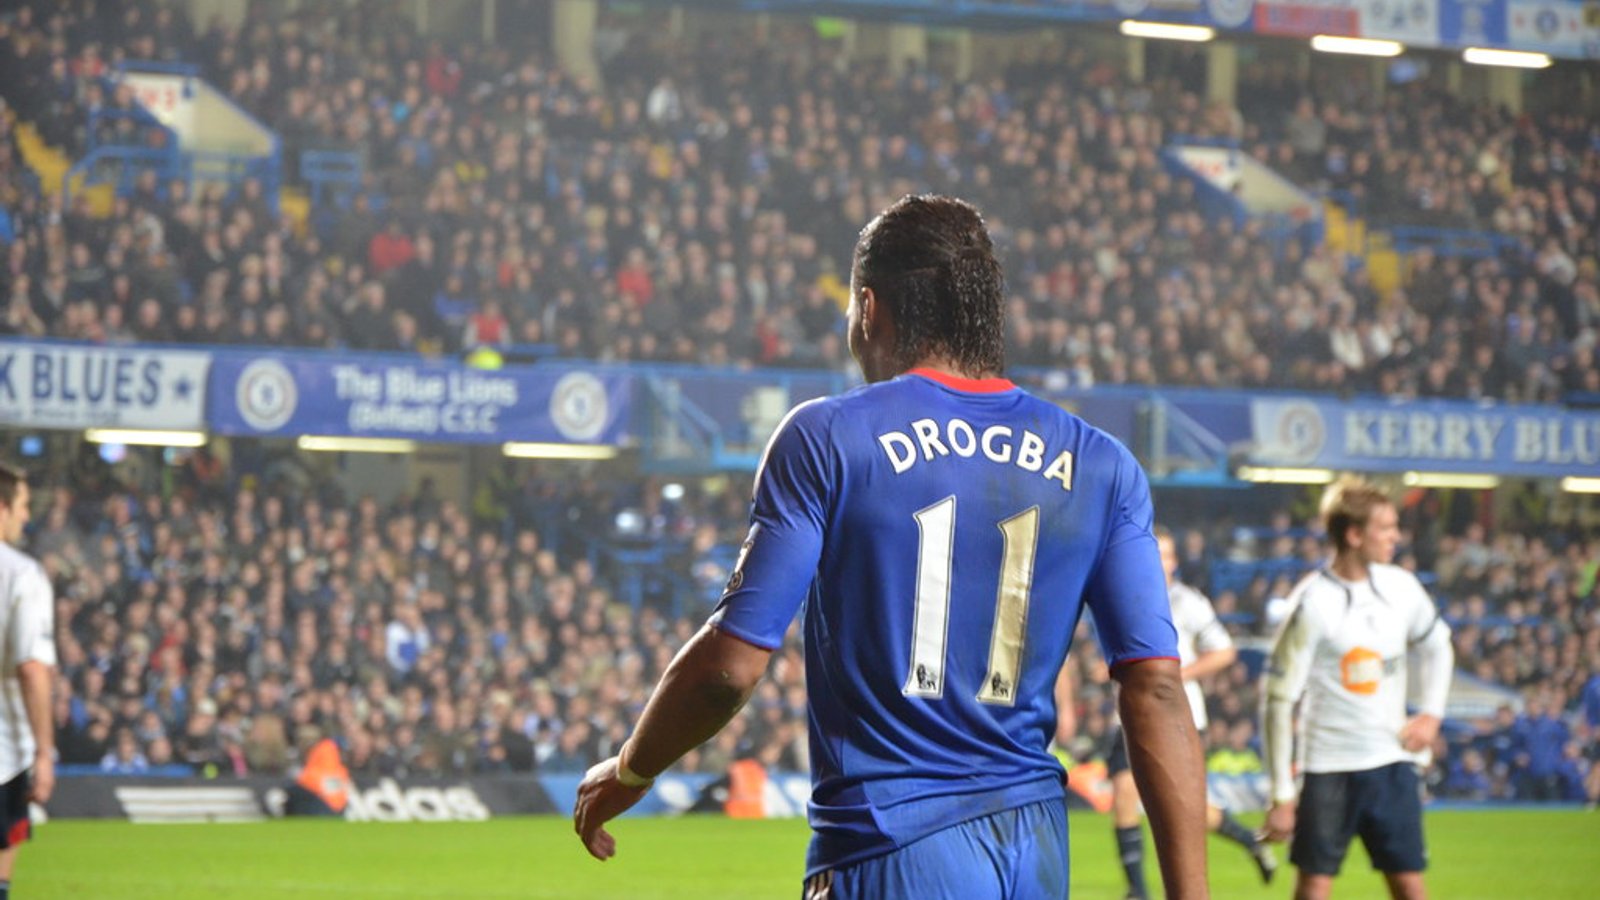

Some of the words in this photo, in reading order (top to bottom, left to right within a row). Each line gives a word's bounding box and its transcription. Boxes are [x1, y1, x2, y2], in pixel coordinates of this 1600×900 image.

[33, 353, 161, 406] BLUES
[333, 364, 382, 401] The
[386, 366, 445, 403] Blue
[878, 418, 1076, 491] DROGBA
[1344, 409, 1502, 460] KERRY
[902, 494, 1041, 707] 11
